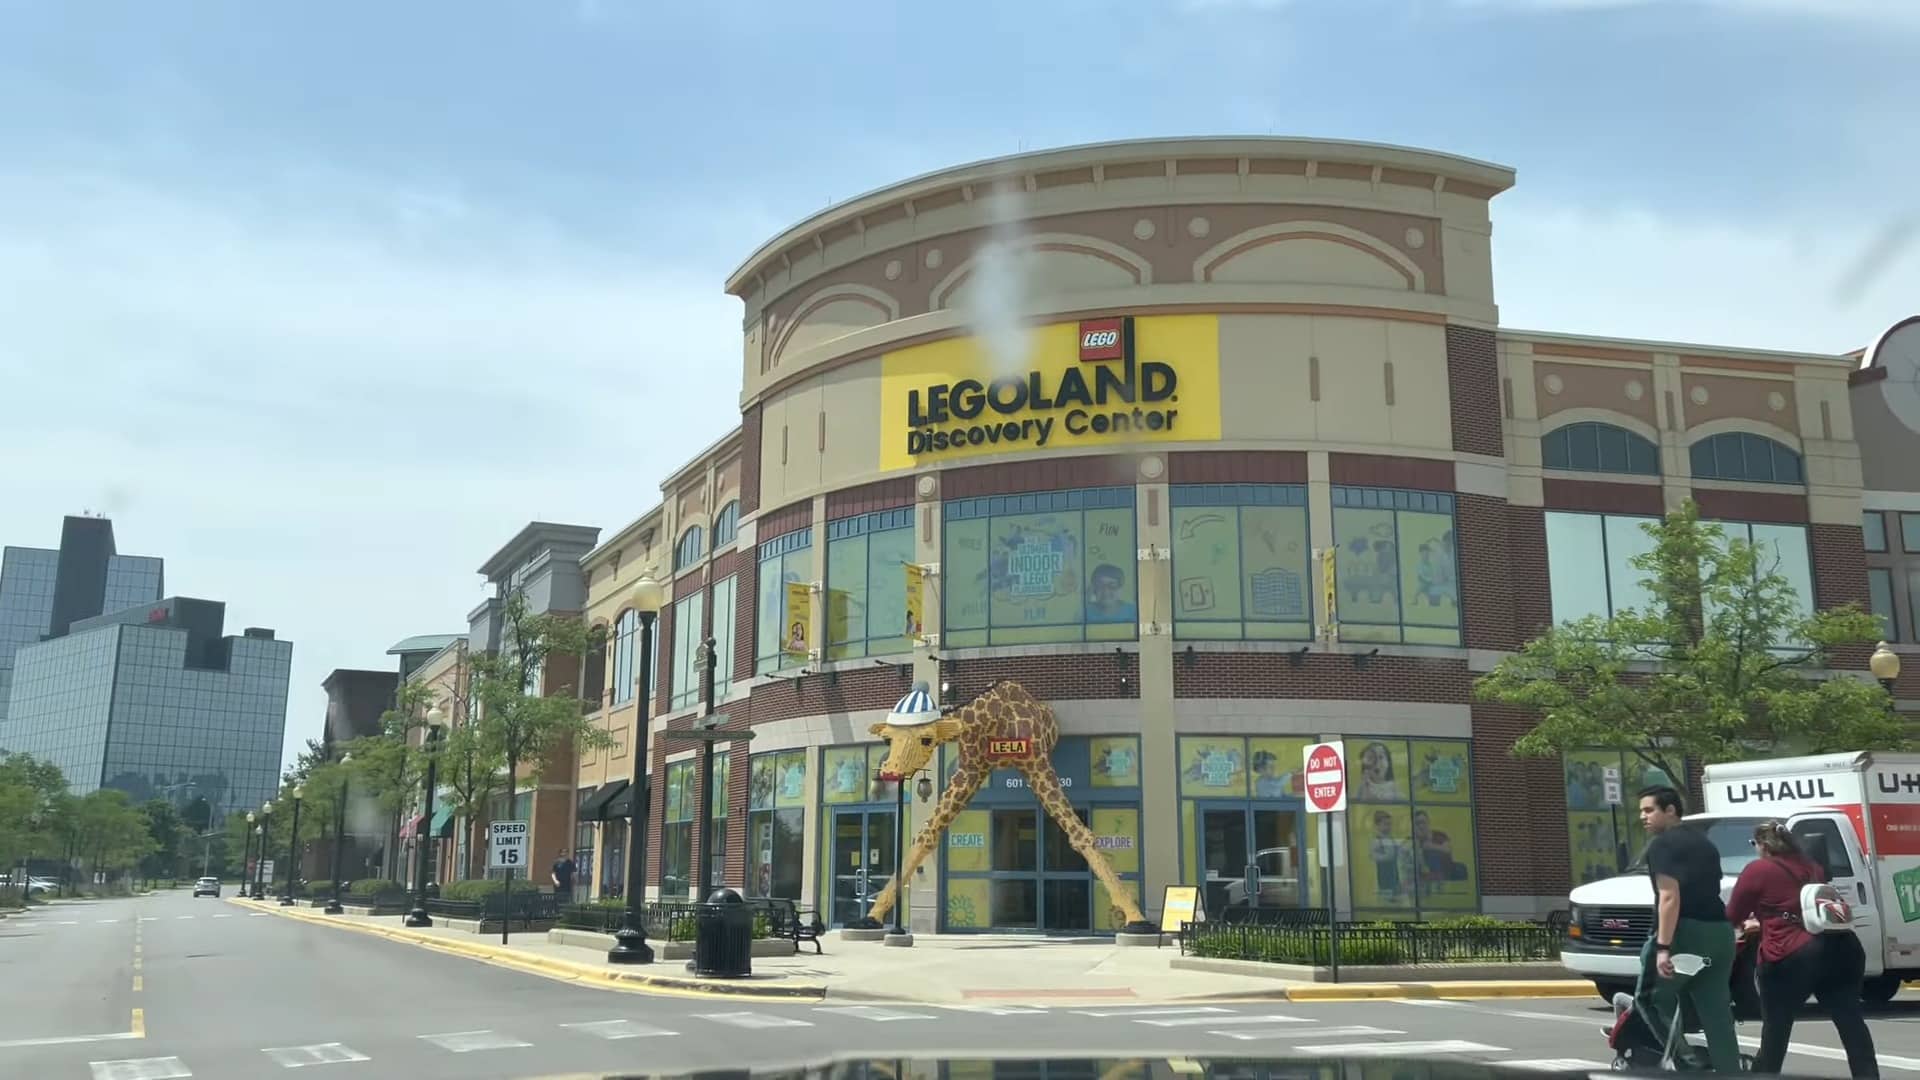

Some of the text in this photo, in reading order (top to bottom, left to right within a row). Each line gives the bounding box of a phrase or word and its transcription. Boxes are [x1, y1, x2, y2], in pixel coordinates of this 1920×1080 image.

[1083, 331, 1117, 347] LEGO
[908, 407, 1178, 455] Discovery Center
[1010, 554, 1060, 573] INDOOR
[1024, 572, 1048, 584] LEGO
[1310, 756, 1337, 769] DO NOT
[1006, 778, 1022, 788] 601
[1314, 786, 1337, 798] ENTER
[1727, 778, 1834, 803] U-HAUL
[493, 824, 526, 833] SPEED
[496, 836, 522, 846] LIMIT
[951, 834, 983, 847] CREATE
[1095, 837, 1131, 848] EXPLORE
[499, 849, 519, 864] 15
